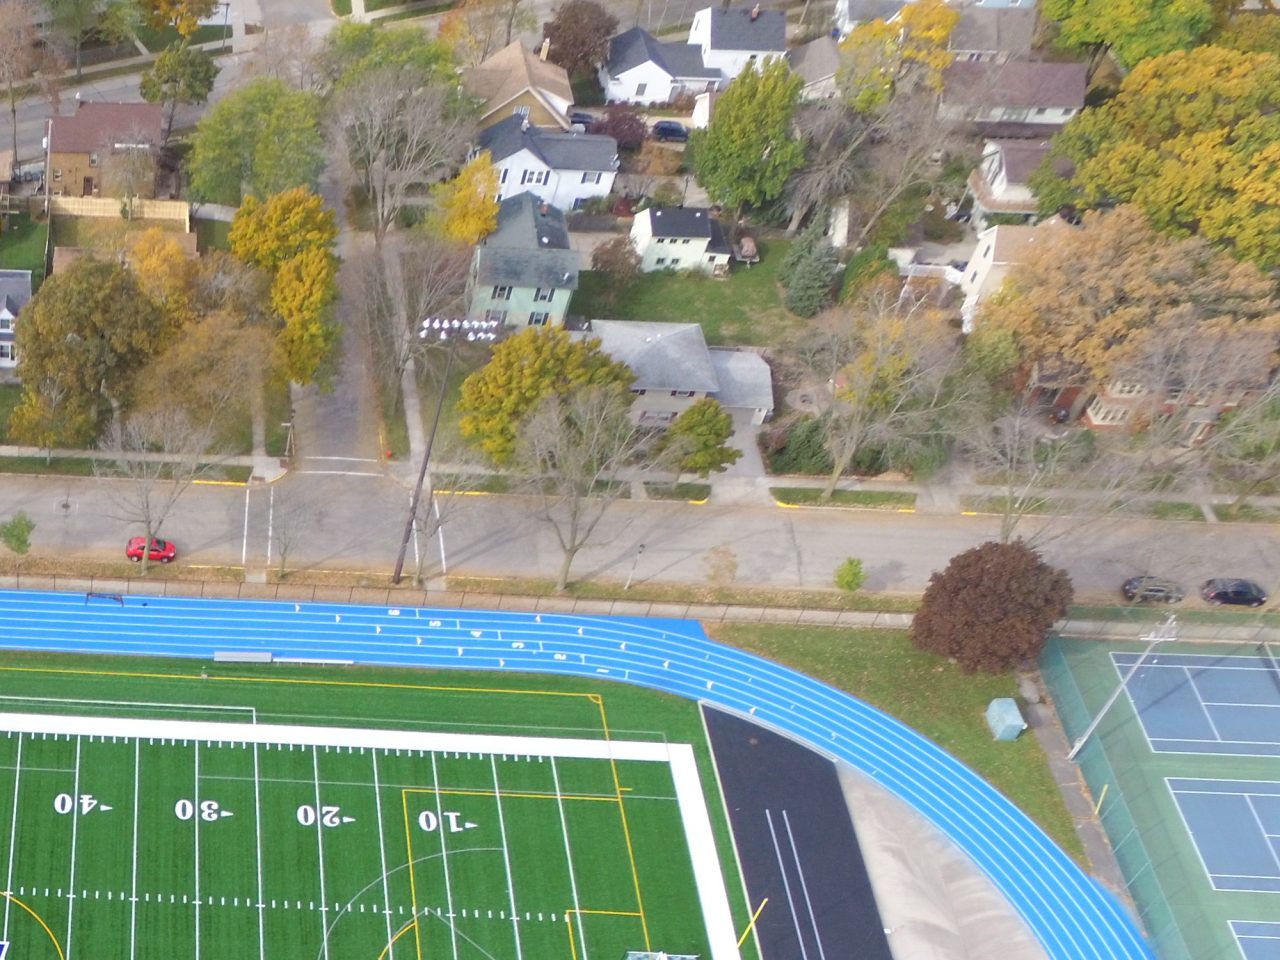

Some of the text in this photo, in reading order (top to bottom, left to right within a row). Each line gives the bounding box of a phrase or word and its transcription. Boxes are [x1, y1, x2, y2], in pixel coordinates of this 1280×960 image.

[53, 792, 98, 816] 40
[174, 798, 219, 822] 30
[296, 804, 341, 828] 20
[418, 810, 463, 834] 10
